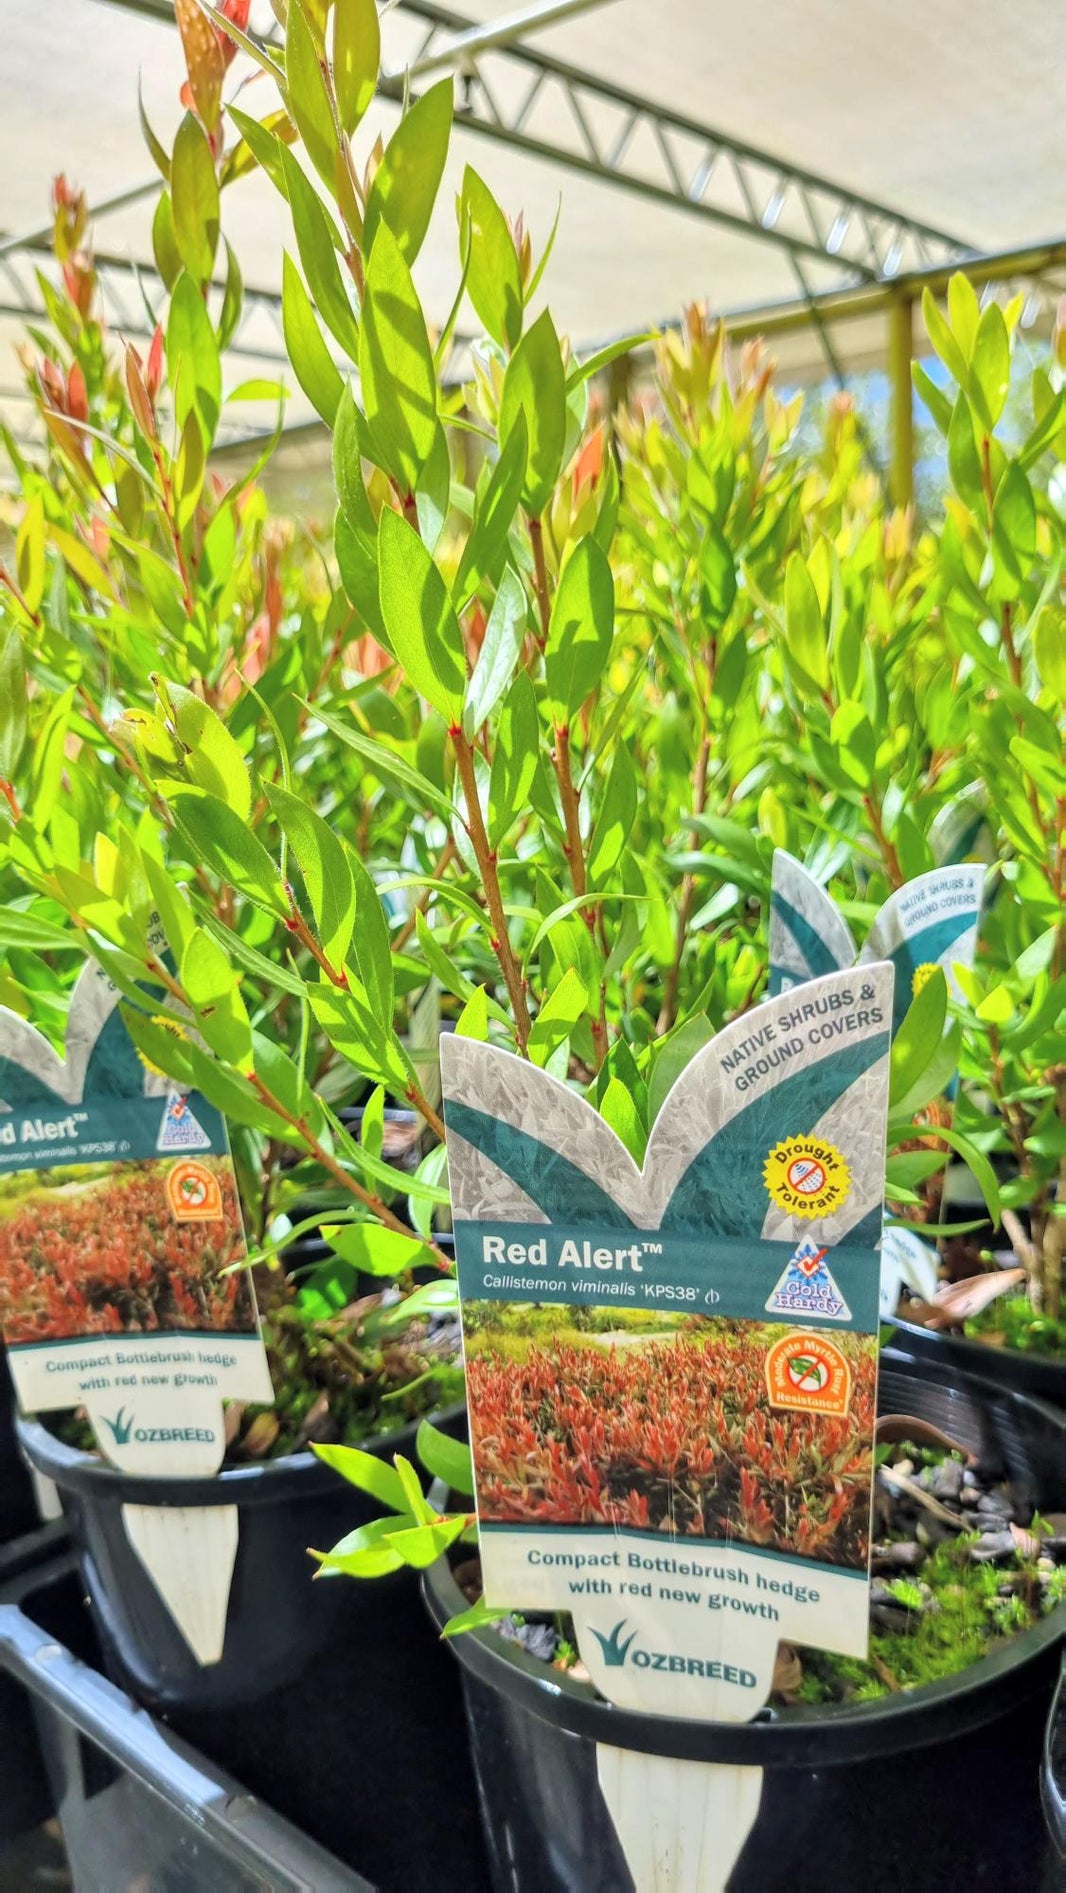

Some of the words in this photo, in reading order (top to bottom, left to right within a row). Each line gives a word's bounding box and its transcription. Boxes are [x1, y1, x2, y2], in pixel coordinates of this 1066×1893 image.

[941, 894, 976, 909] COVERS
[720, 1024, 777, 1073] NATIVE
[778, 989, 854, 1032] SHRUBS
[860, 984, 875, 1000] &
[735, 1037, 804, 1091] GROUND
[808, 1007, 883, 1045] COVERS
[775, 1144, 839, 1171] Drought
[777, 1182, 840, 1209] Tolerant
[483, 1236, 547, 1266] Red
[483, 1274, 566, 1291] Callistemon
[571, 1279, 635, 1295] viminalis
[785, 1281, 832, 1298] Cold
[776, 1293, 844, 1316] Hardy
[46, 1354, 111, 1373] Compact
[116, 1351, 194, 1365] Bottlebrush
[198, 1352, 236, 1368] hedge
[804, 1339, 837, 1367] Myrtle
[79, 1376, 110, 1391] with
[115, 1374, 137, 1387] red
[142, 1375, 168, 1385] new
[174, 1373, 218, 1387] growth
[135, 1427, 215, 1443] OZBREED
[528, 1550, 620, 1568] Compact
[628, 1552, 749, 1585] Bottlebrush
[756, 1573, 820, 1603] hedge
[569, 1578, 612, 1595] with
[620, 1581, 652, 1597] red
[659, 1587, 701, 1604] new
[708, 1592, 780, 1622] growth
[631, 1649, 757, 1689] OZBREED
